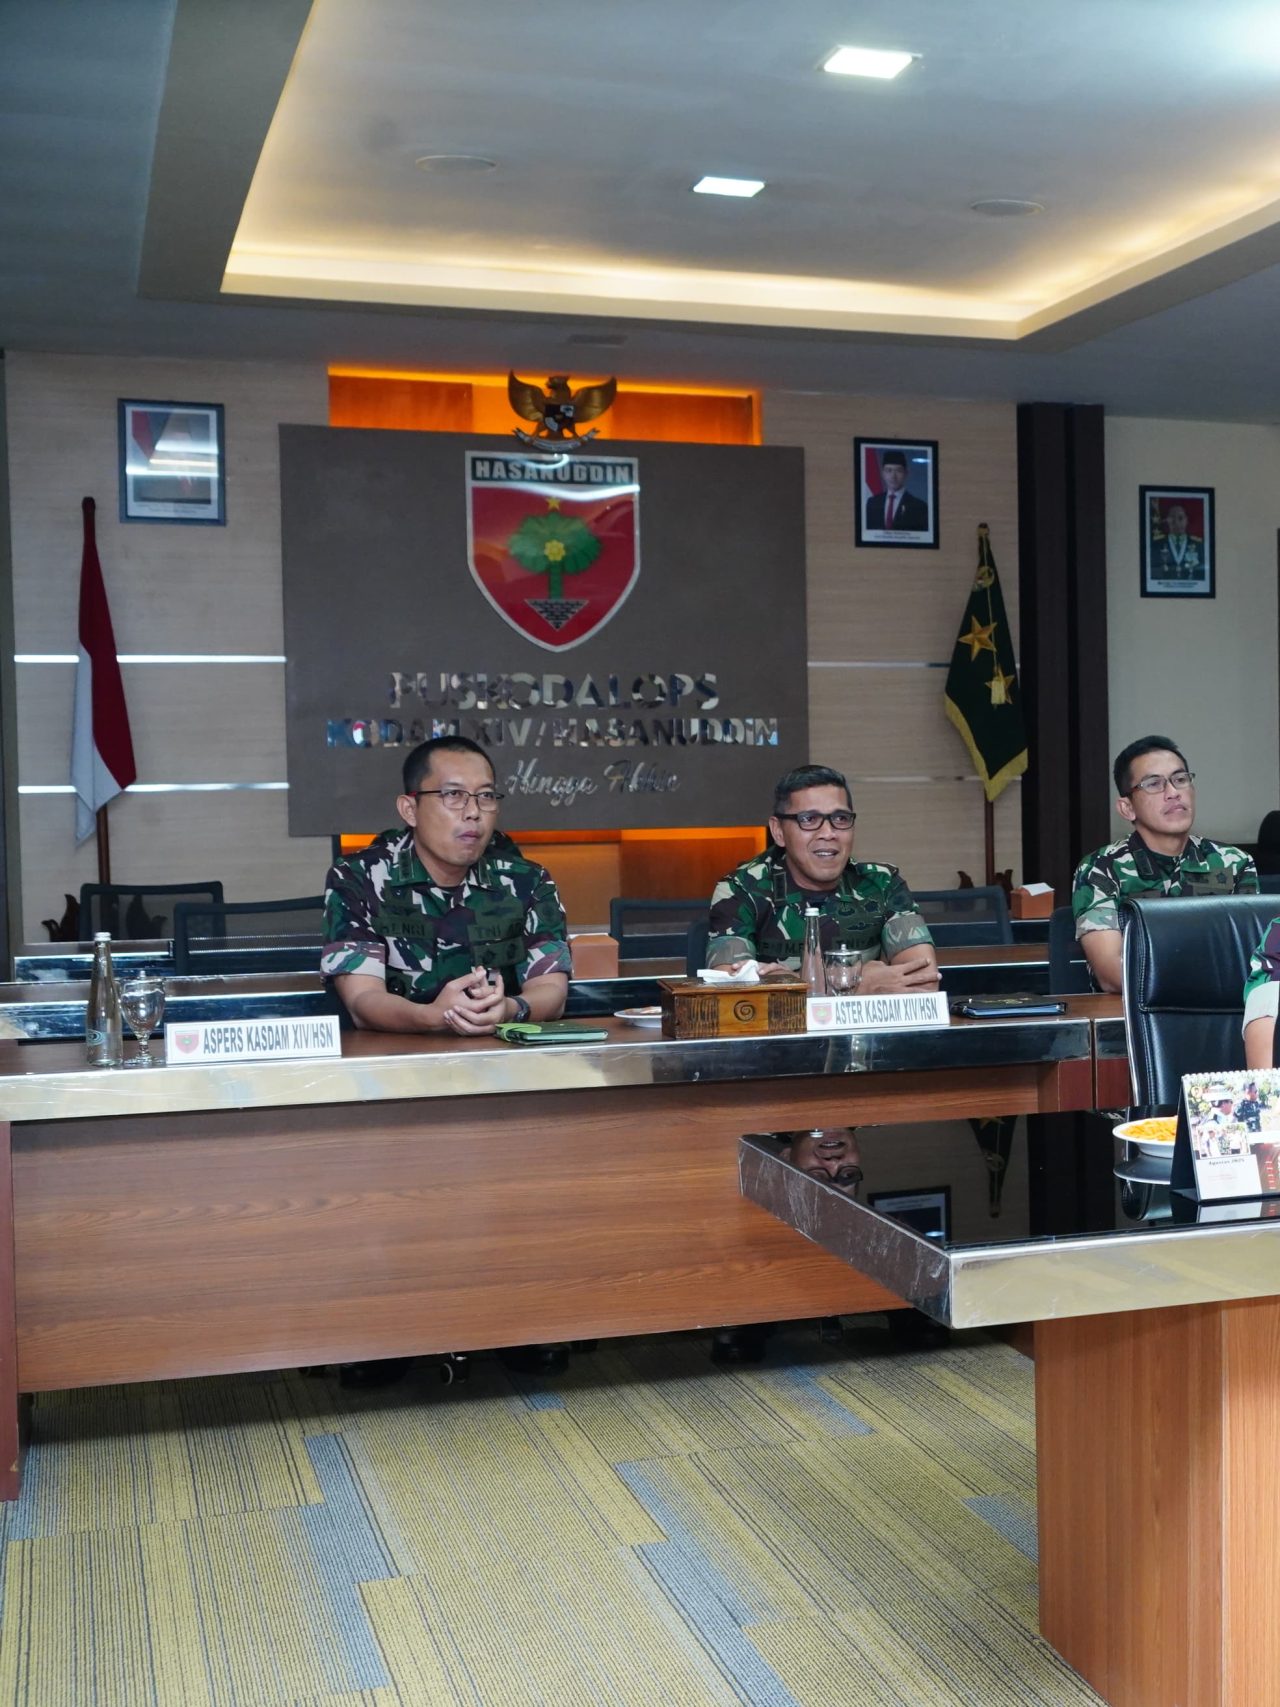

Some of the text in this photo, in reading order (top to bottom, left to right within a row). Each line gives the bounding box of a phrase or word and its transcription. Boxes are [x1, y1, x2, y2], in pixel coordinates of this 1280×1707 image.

[474, 459, 630, 483] HASANUDDIN
[835, 997, 938, 1025] ASTER KASDAM XIV/HSN
[203, 1022, 334, 1054] ASPERS KASDAM XIV/HSN
